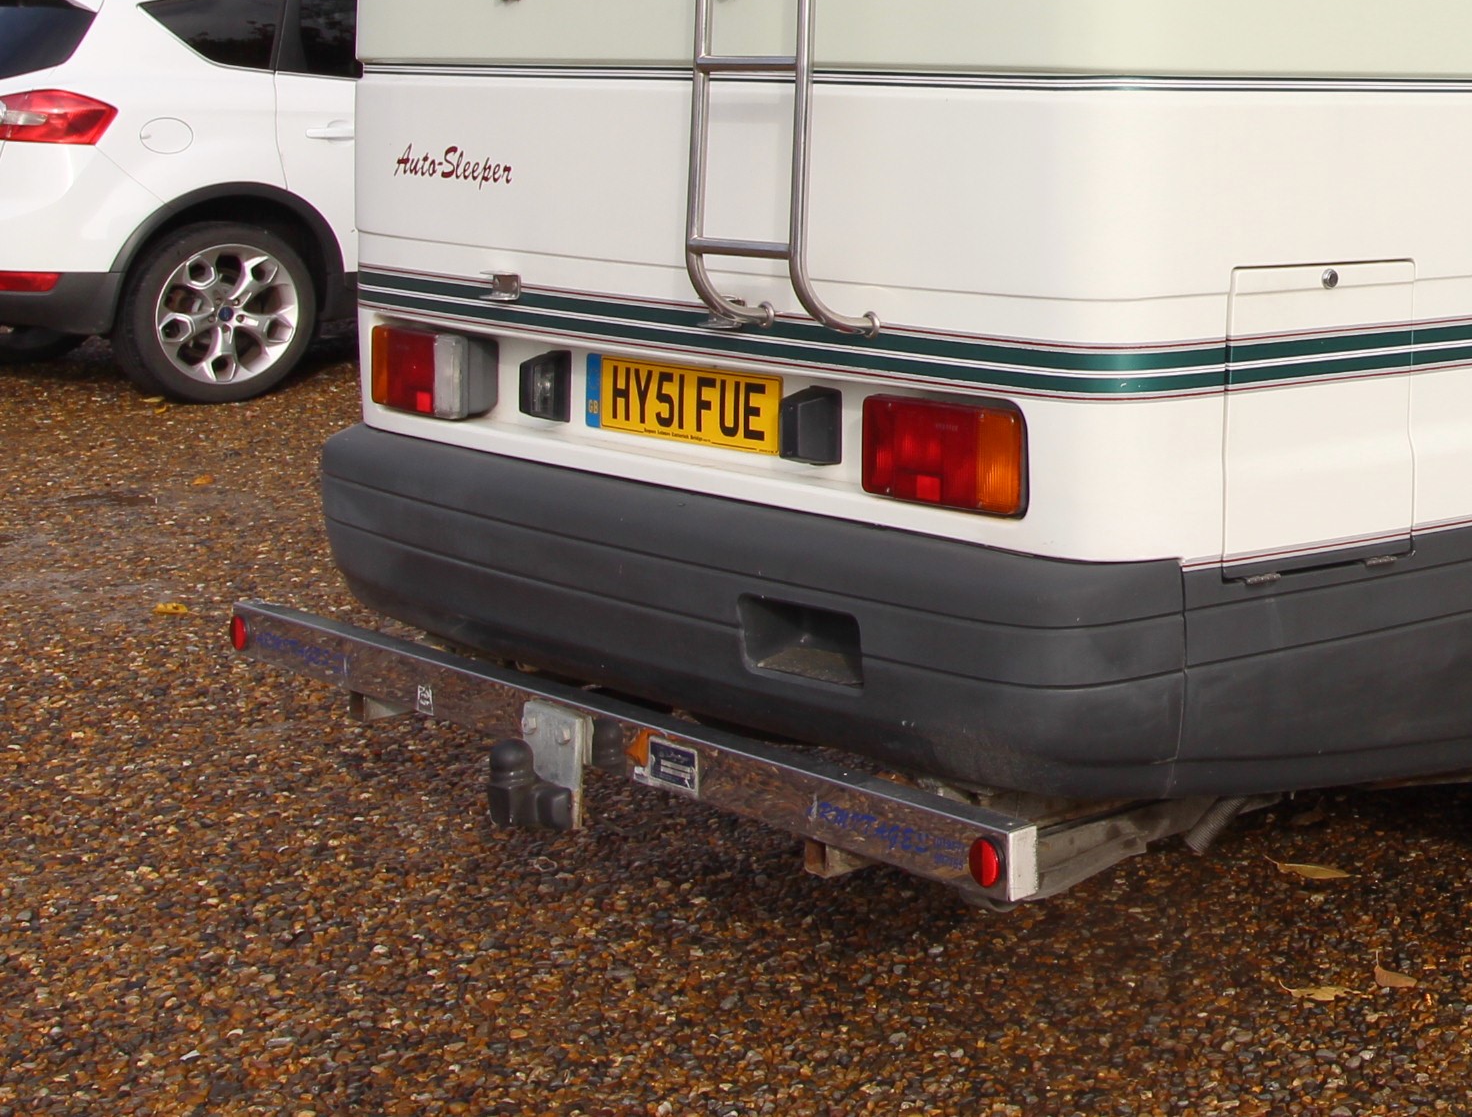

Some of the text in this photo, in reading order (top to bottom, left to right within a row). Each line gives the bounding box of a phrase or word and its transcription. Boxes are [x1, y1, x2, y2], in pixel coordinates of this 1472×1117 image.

[394, 143, 512, 190] Auto-Sleeper
[588, 399, 598, 414] GB
[612, 365, 767, 442] HY51 FUE
